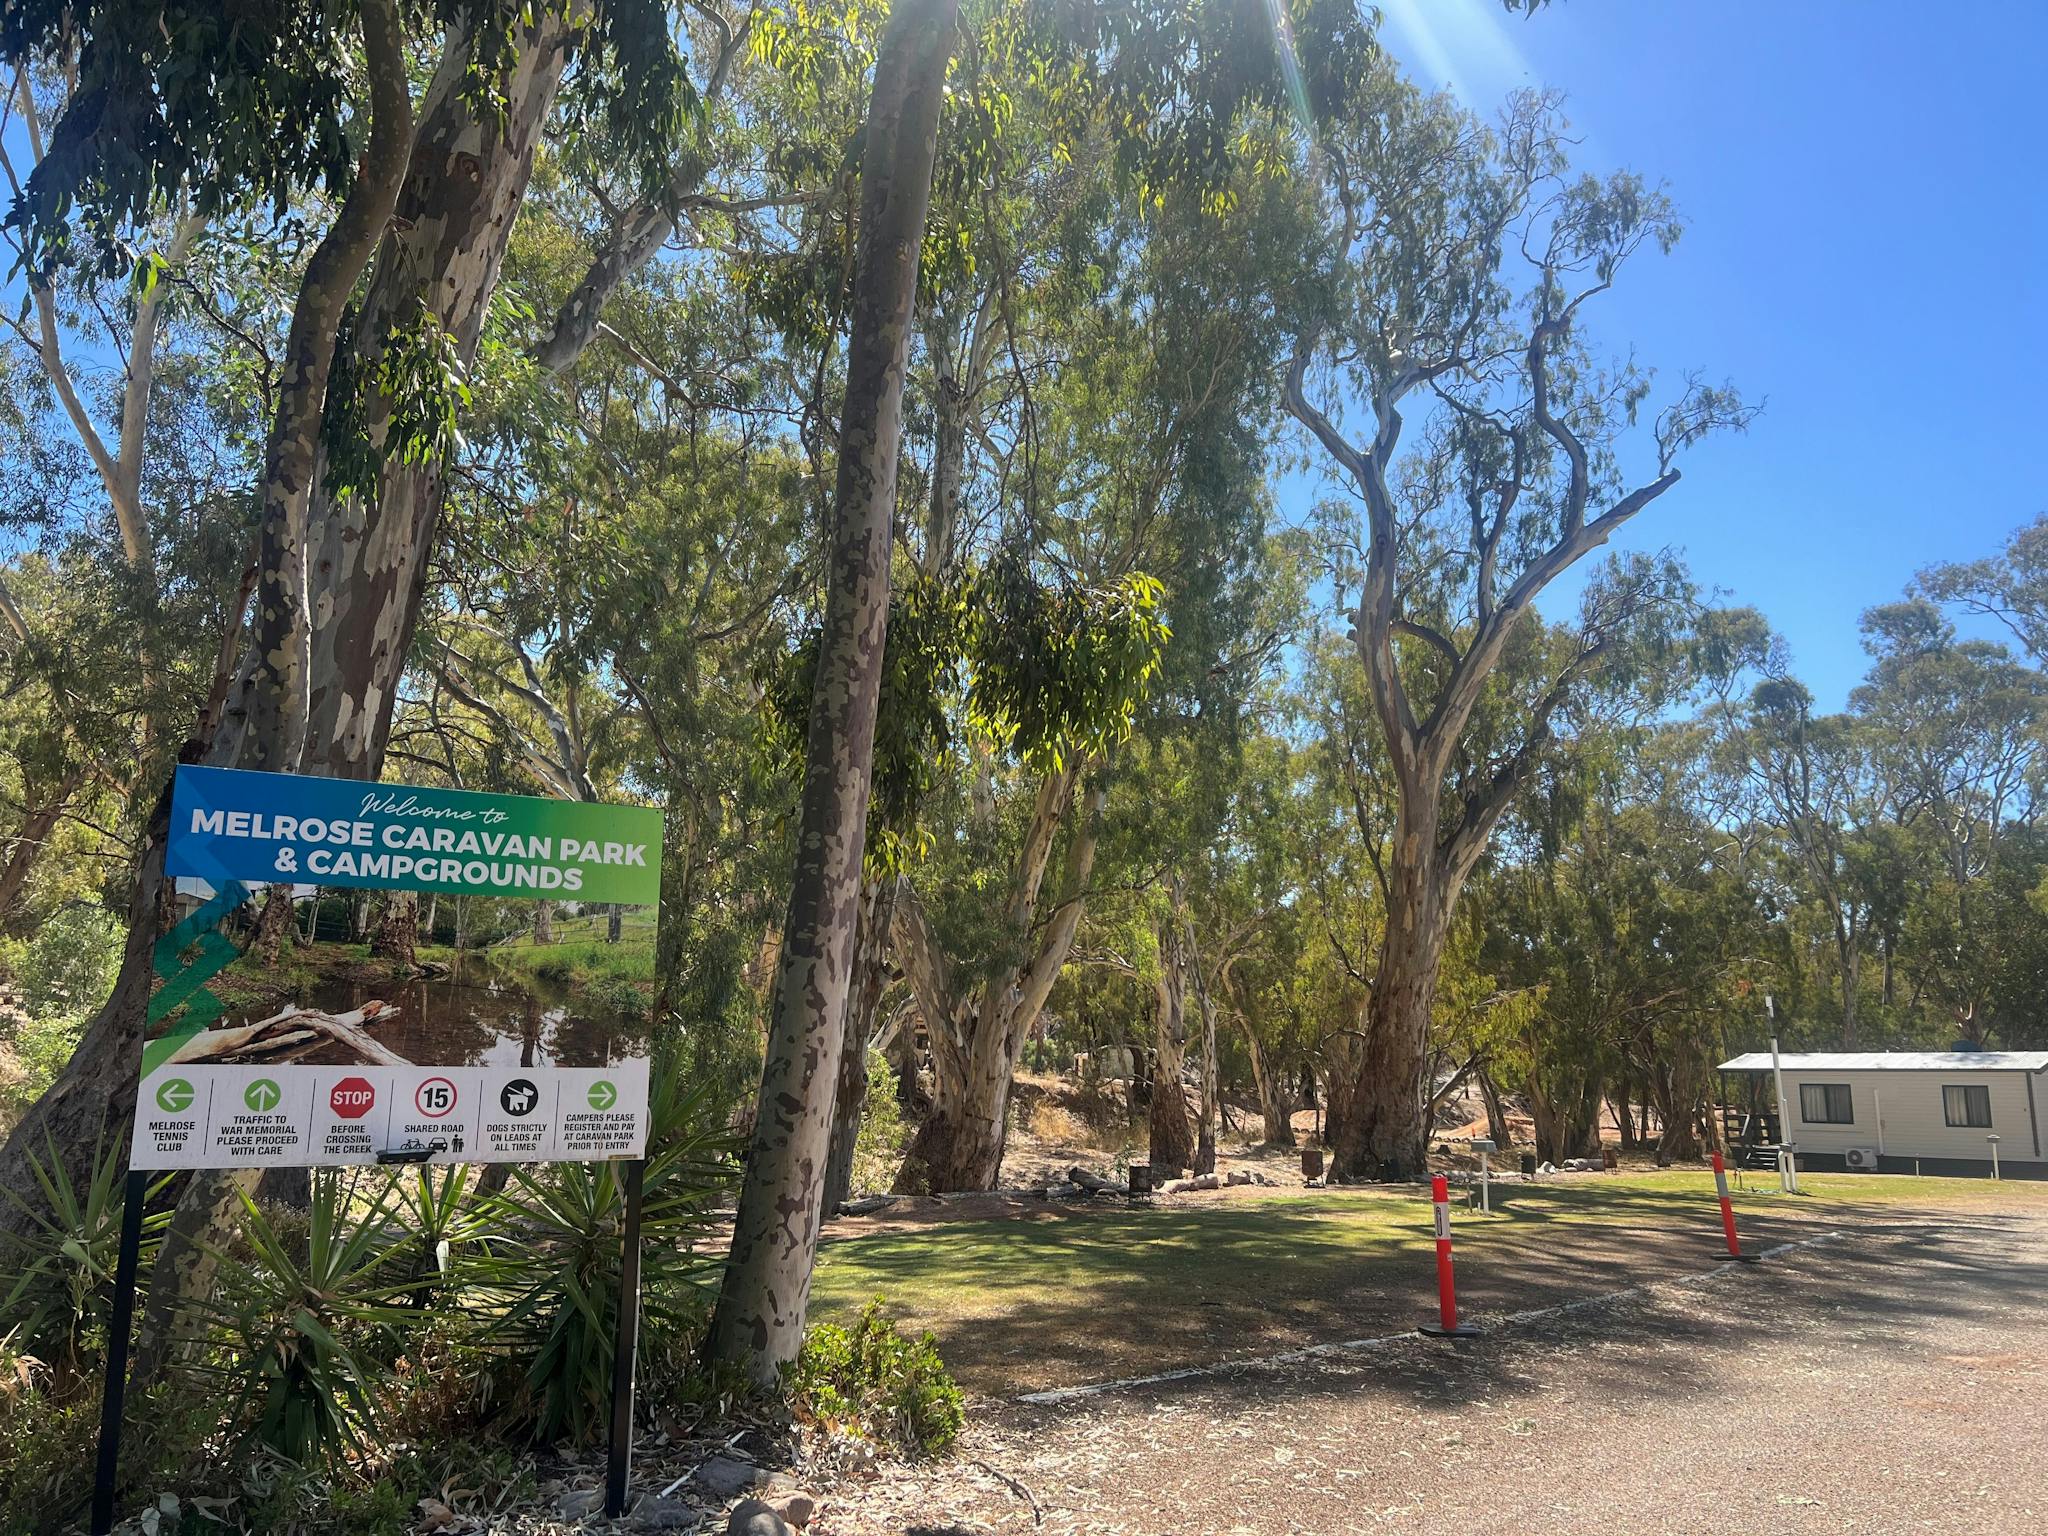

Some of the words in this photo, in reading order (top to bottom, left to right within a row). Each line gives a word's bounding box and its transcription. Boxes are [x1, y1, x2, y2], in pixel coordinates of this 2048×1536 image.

[359, 792, 476, 822] Welcome
[479, 807, 510, 824] to
[190, 808, 374, 846] MELROSE
[381, 824, 552, 860] CARAVAN
[559, 838, 648, 867] PARK
[274, 847, 298, 873] &
[307, 850, 584, 891] CAMPGROUNDS
[333, 1091, 372, 1105] STOP
[423, 1087, 449, 1109] 15
[233, 1115, 273, 1124] TRAFFIC
[274, 1115, 287, 1124] TO
[566, 1113, 604, 1122] CAMPERS
[606, 1113, 635, 1121] PLEASE
[148, 1121, 196, 1131] MELROSE
[220, 1126, 243, 1135] WAR
[245, 1125, 297, 1135] MEMORIAL
[331, 1125, 366, 1134] BEFORE
[404, 1124, 440, 1133] SHARED
[441, 1124, 464, 1133] ROAD
[486, 1124, 509, 1132] DOGS
[510, 1123, 548, 1132] STRICTLY
[564, 1123, 601, 1131] REGISTER
[603, 1123, 620, 1131] AND
[621, 1123, 636, 1131] PAY
[153, 1132, 189, 1141] TENNIS
[216, 1136, 253, 1146] PLEASE
[255, 1135, 298, 1145] PROCEED
[326, 1135, 372, 1144] CROSSING
[490, 1133, 502, 1142] ON
[504, 1133, 530, 1142] LEADS
[531, 1133, 542, 1141] AT
[563, 1133, 574, 1141] AT
[575, 1132, 612, 1141] CARAVAN
[613, 1132, 634, 1140] PARK
[156, 1143, 182, 1152] CLUB
[323, 1145, 343, 1154] THE
[344, 1145, 372, 1154] CREEK
[494, 1143, 510, 1151] ALL
[511, 1143, 537, 1151] TIMES
[567, 1142, 592, 1150] PRIOR
[594, 1142, 604, 1150] TO
[605, 1141, 630, 1150] ENTRY
[231, 1147, 255, 1156] WITH
[257, 1146, 283, 1155] CARE
